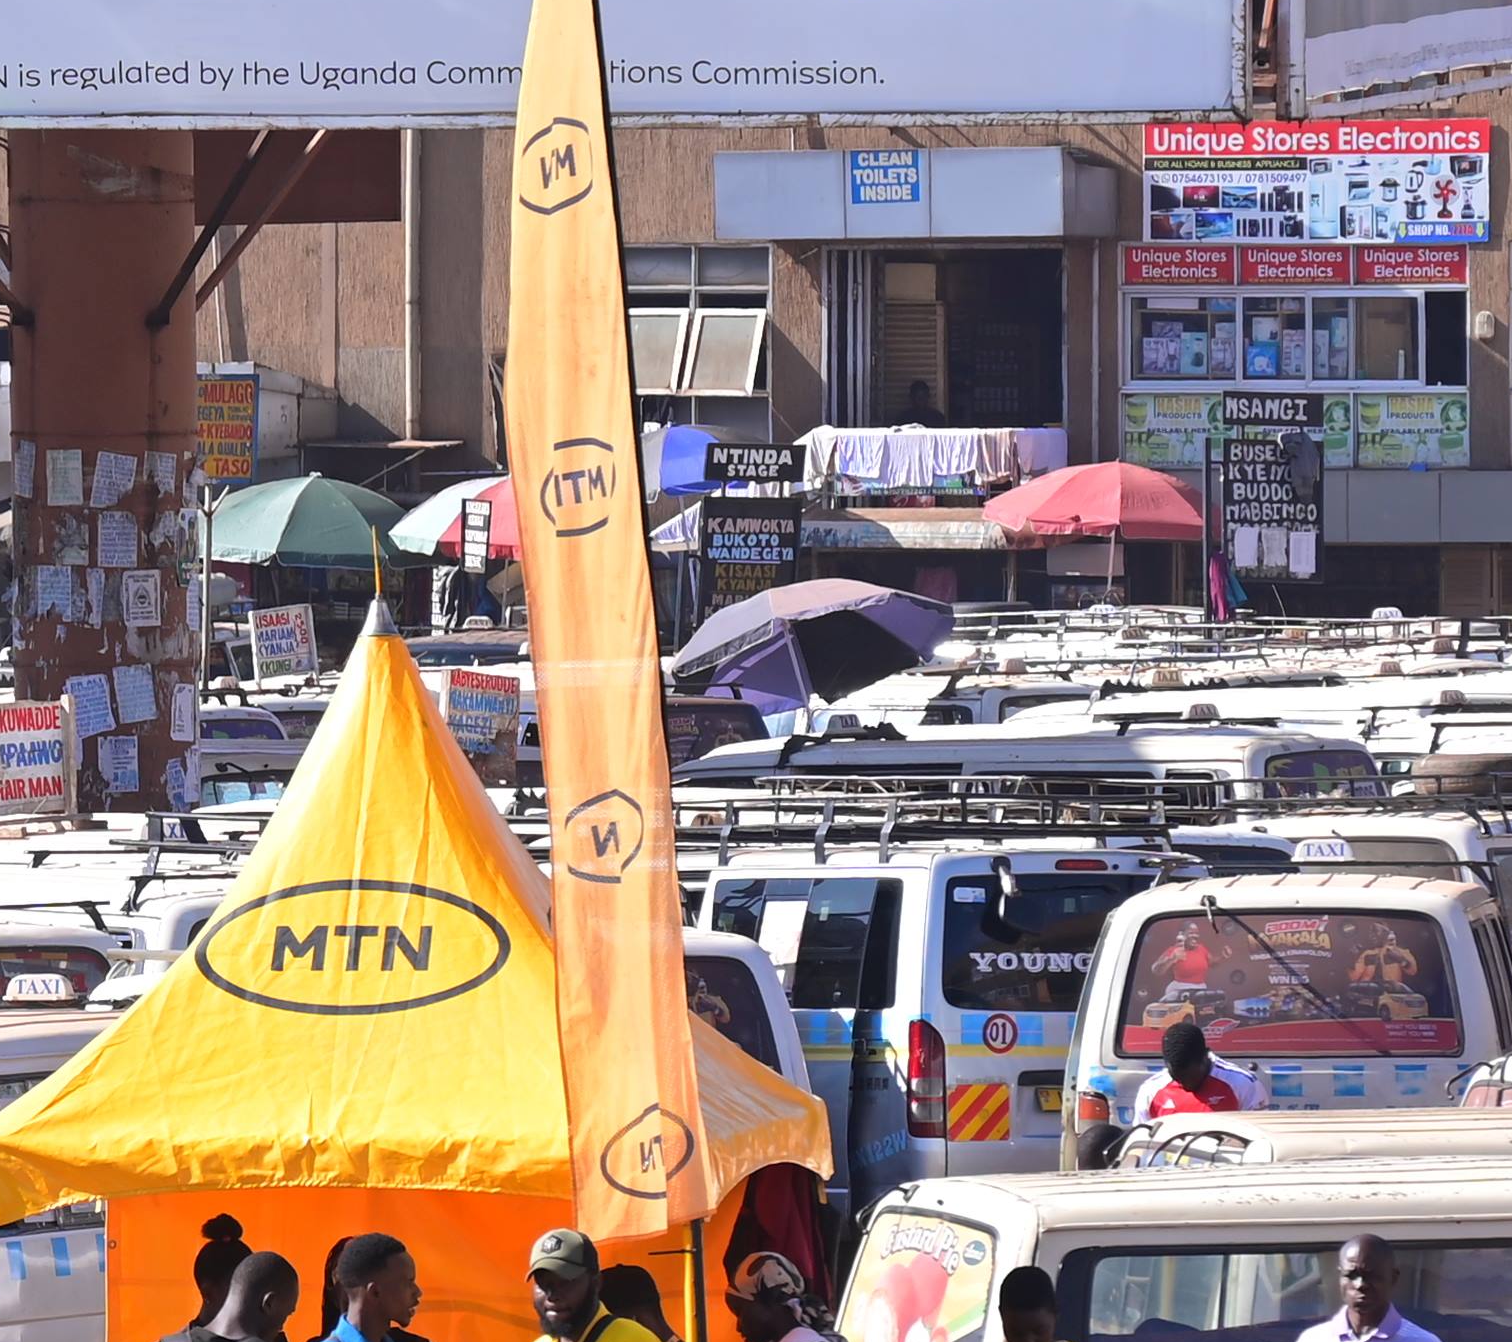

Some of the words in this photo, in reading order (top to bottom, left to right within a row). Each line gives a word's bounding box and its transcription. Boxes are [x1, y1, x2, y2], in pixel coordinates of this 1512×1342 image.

[19, 62, 41, 89] is
[51, 60, 189, 91] regulated
[199, 60, 233, 91] by
[243, 60, 290, 86] the
[299, 60, 417, 91] Uganda
[692, 59, 886, 86] Commission.
[1153, 127, 1245, 157] Unique
[1252, 127, 1331, 151] Stores
[1338, 126, 1480, 151] Electronics
[858, 152, 913, 168] CLEAN
[853, 168, 918, 185] TOILETS
[1171, 172, 1234, 184] 0754673193
[859, 185, 913, 202] INSIDE
[1132, 248, 1182, 264] Unique
[1185, 248, 1227, 262] Stores
[1248, 248, 1298, 264] Unique
[1301, 248, 1343, 262] Stores
[1364, 248, 1414, 264] Unique
[1417, 248, 1459, 262] Stores
[1141, 264, 1217, 278] Electronics
[1257, 264, 1333, 278] Electronics
[1374, 263, 1450, 278] Electronics
[713, 448, 793, 465] NTINDA
[727, 464, 779, 477] STAGE
[707, 517, 794, 534] KAMWOKYA
[713, 534, 779, 546] BUKOTO
[707, 547, 794, 560] WANDEGEYA
[1306, 843, 1345, 857] TAXI
[270, 924, 433, 973] MTN
[16, 979, 60, 995] TAXI
